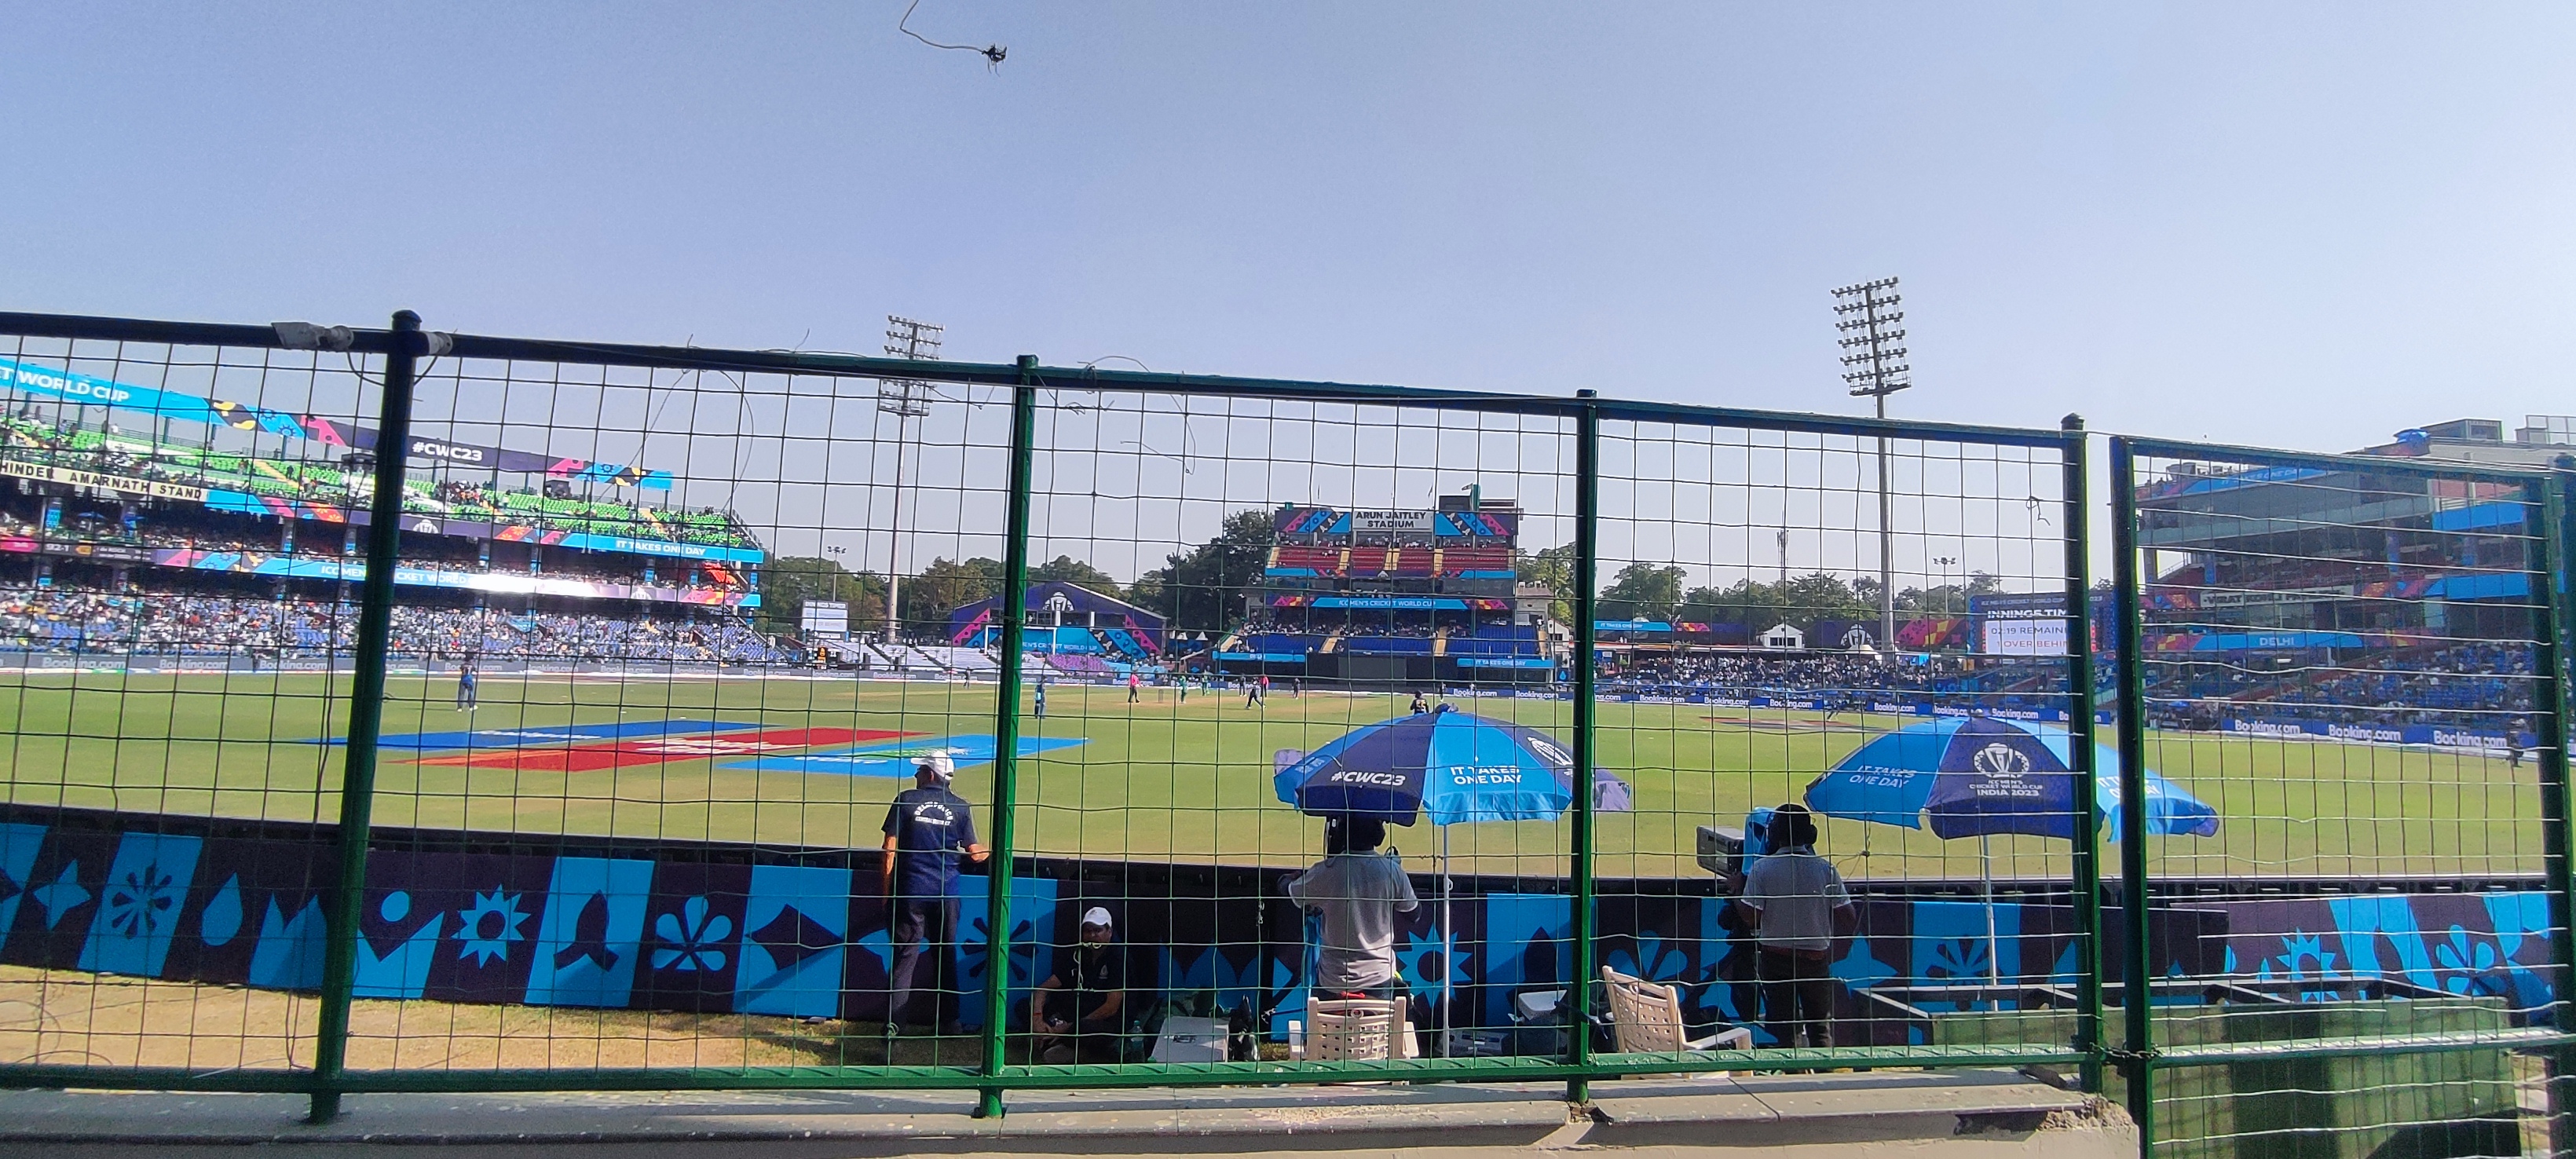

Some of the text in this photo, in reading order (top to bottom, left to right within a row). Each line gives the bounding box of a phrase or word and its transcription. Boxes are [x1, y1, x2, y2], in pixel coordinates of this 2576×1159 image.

[18, 371, 90, 394] WORLD
[93, 386, 130, 401] CUP
[412, 441, 482, 461] #CWC23
[69, 472, 149, 492] AMARNATH
[159, 484, 202, 499] STAND
[629, 541, 661, 552] TAKES
[686, 547, 706, 556] DAY
[342, 566, 366, 577] MEN
[396, 572, 425, 582] CKET
[427, 573, 467, 584] WORLD
[1987, 609, 2042, 619] INNINGS
[2259, 637, 2294, 645] DELHI
[2234, 718, 2300, 735] Booking.com
[2328, 723, 2402, 742] Booking.com
[1331, 770, 1406, 786] #CWC23
[1451, 766, 1465, 775] IT
[1454, 775, 1521, 784] ONE DAY
[1849, 774, 1910, 788] ONE DAY
